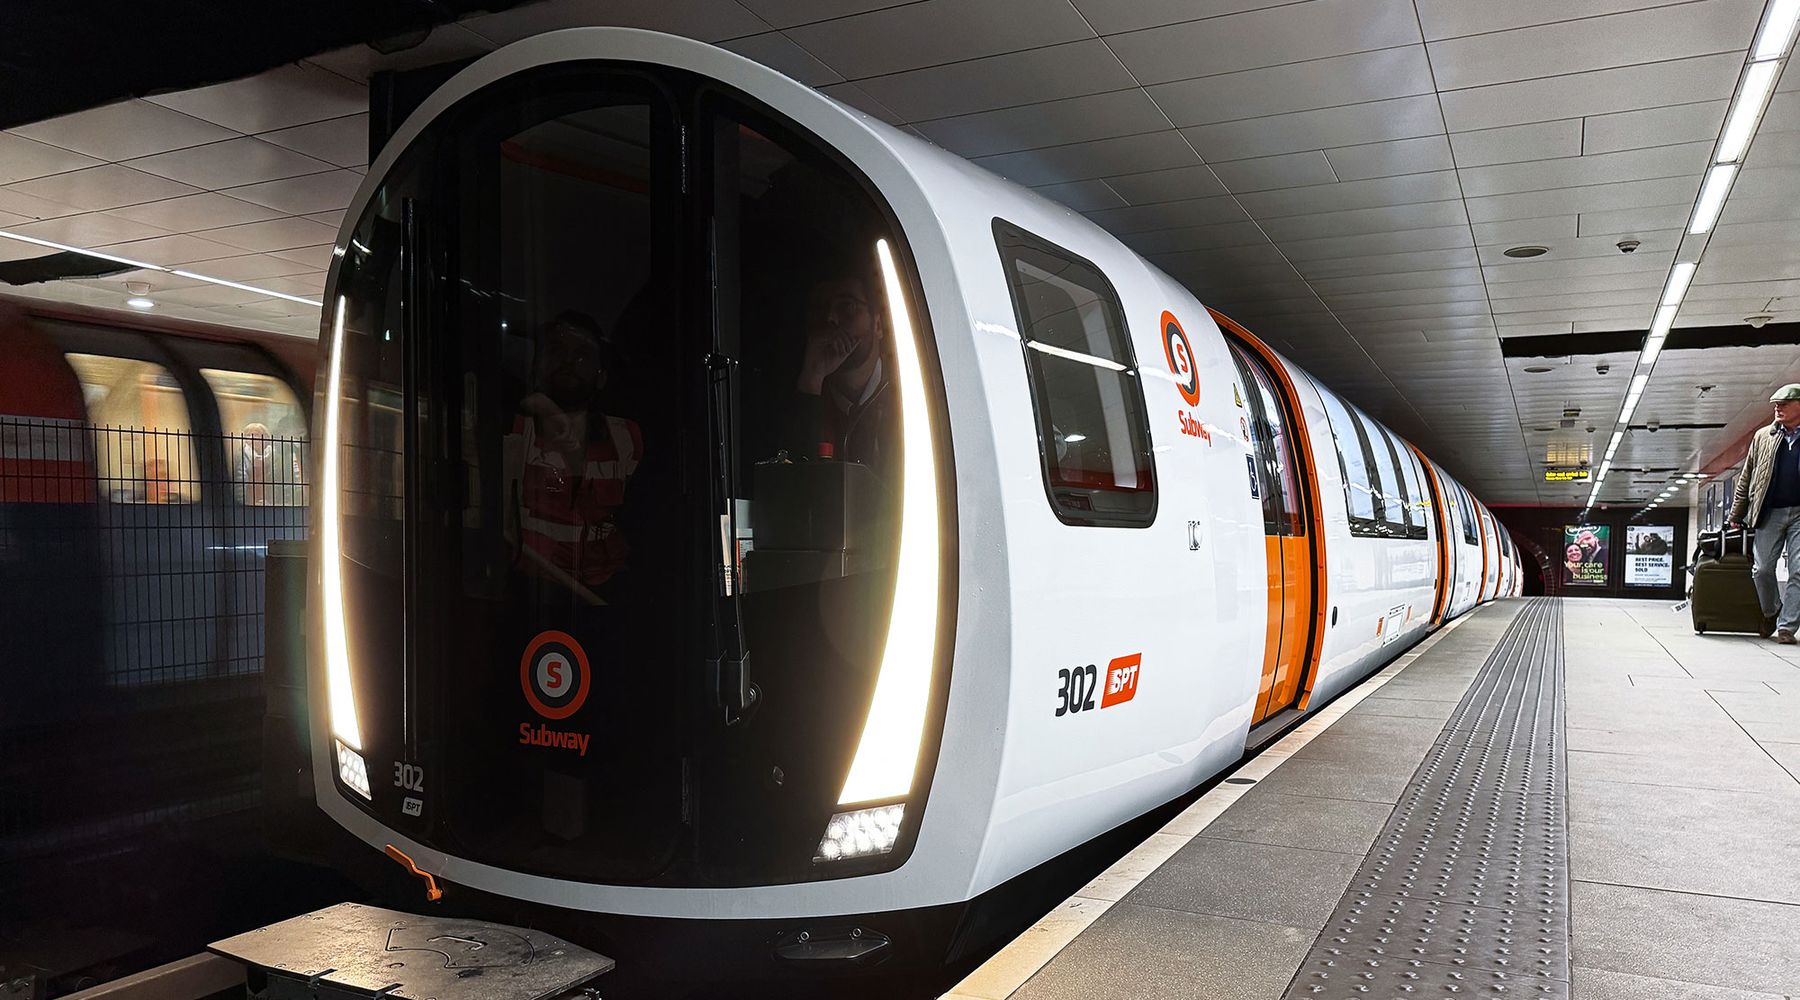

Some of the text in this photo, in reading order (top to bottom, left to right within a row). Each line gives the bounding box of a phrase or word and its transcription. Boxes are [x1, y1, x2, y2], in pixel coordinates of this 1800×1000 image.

[1178, 410, 1212, 447] Subway
[1572, 572, 1608, 580] business
[1055, 664, 1139, 717] 302 SPT
[519, 722, 590, 756] Subway
[394, 761, 424, 792] 302
